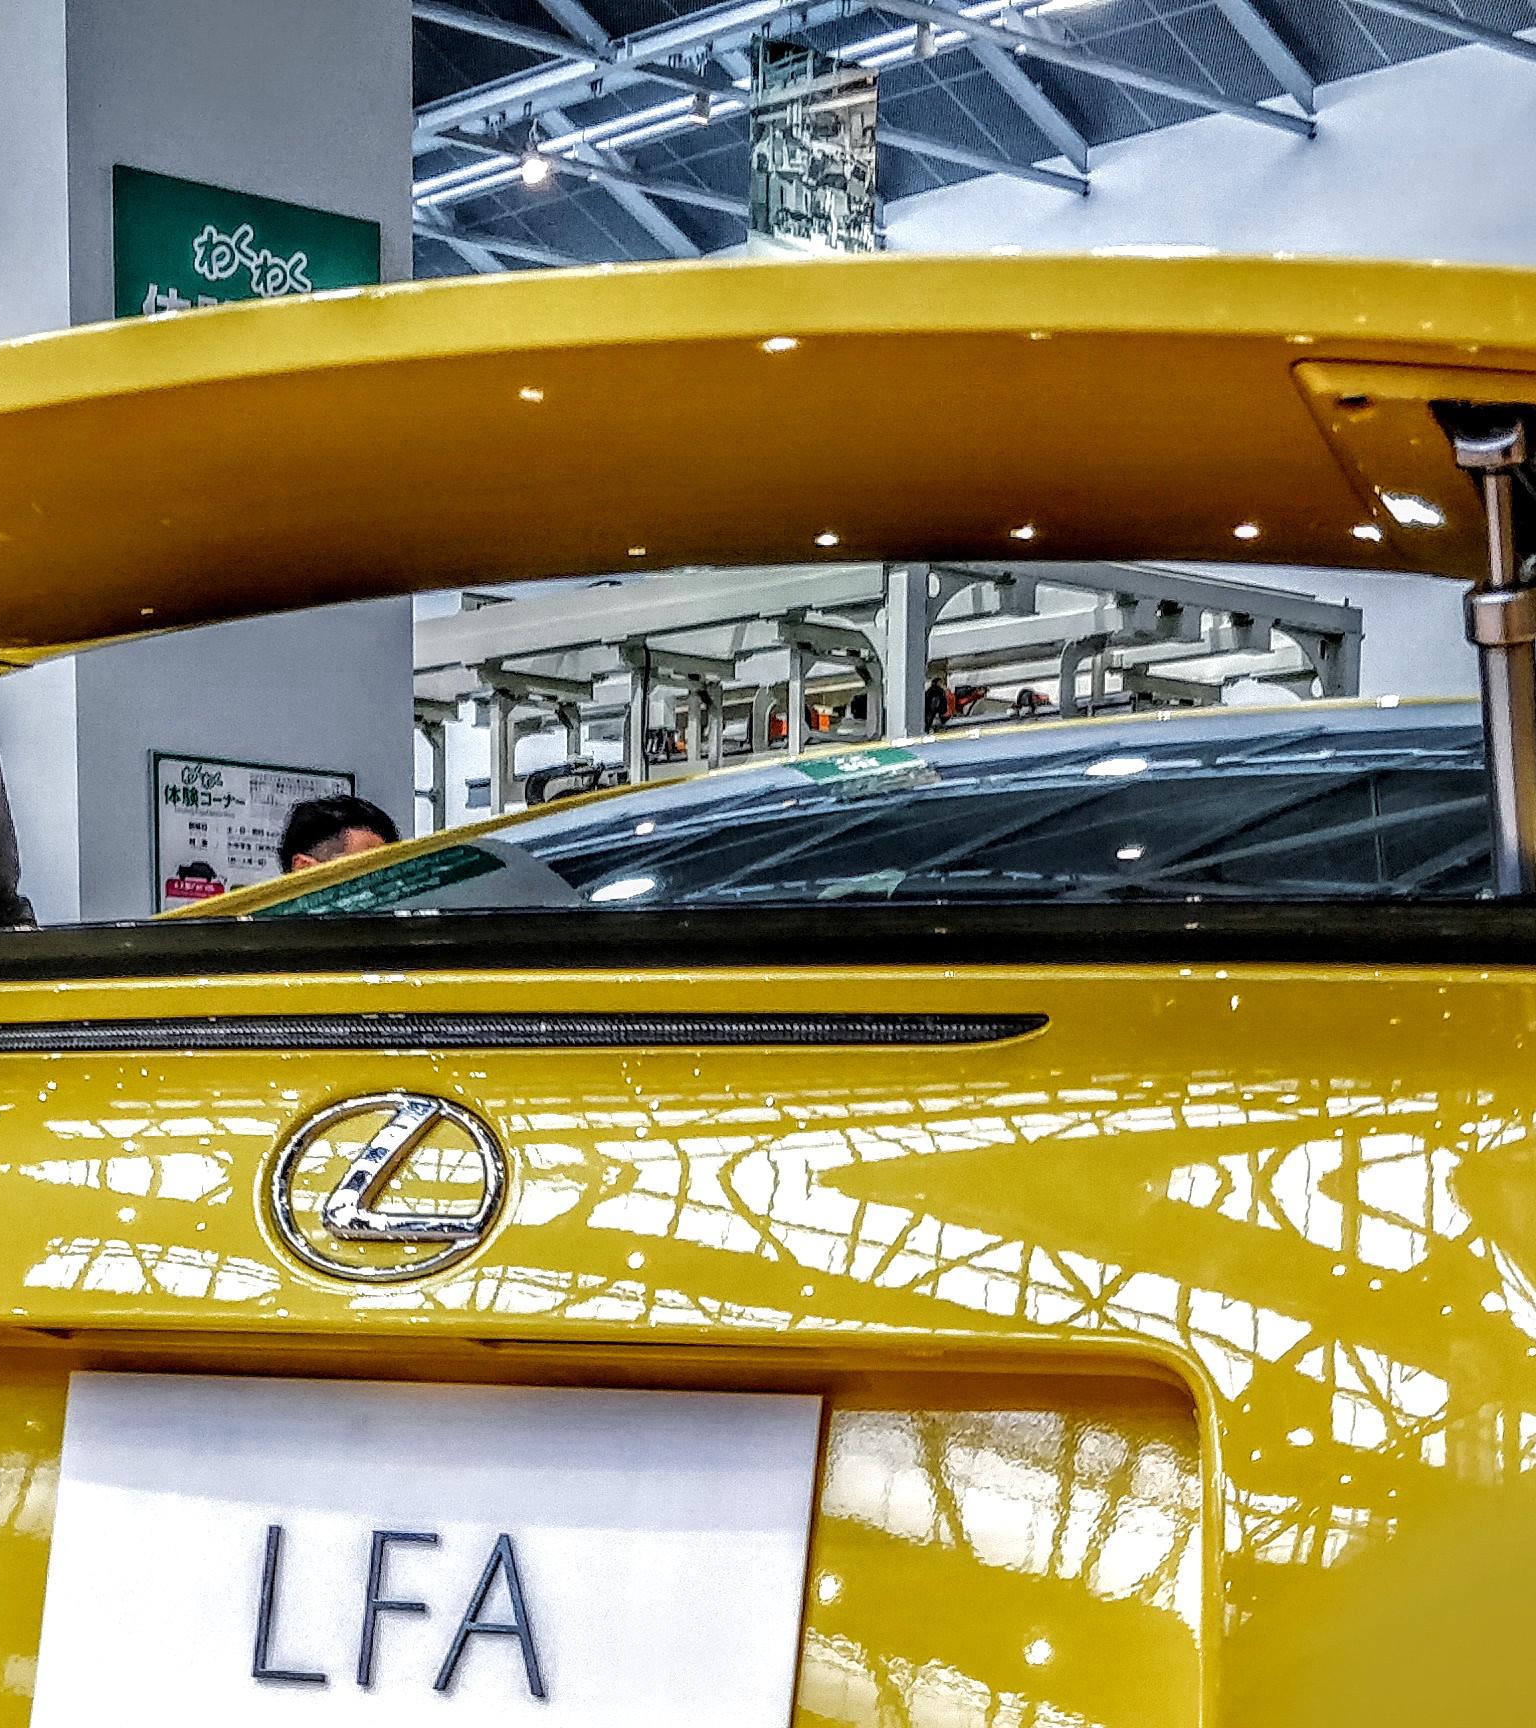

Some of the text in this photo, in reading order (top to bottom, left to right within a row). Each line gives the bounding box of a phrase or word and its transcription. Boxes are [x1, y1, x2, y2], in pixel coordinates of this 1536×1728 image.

[192, 222, 313, 298] わくわく
[251, 1524, 550, 1700] LFA
